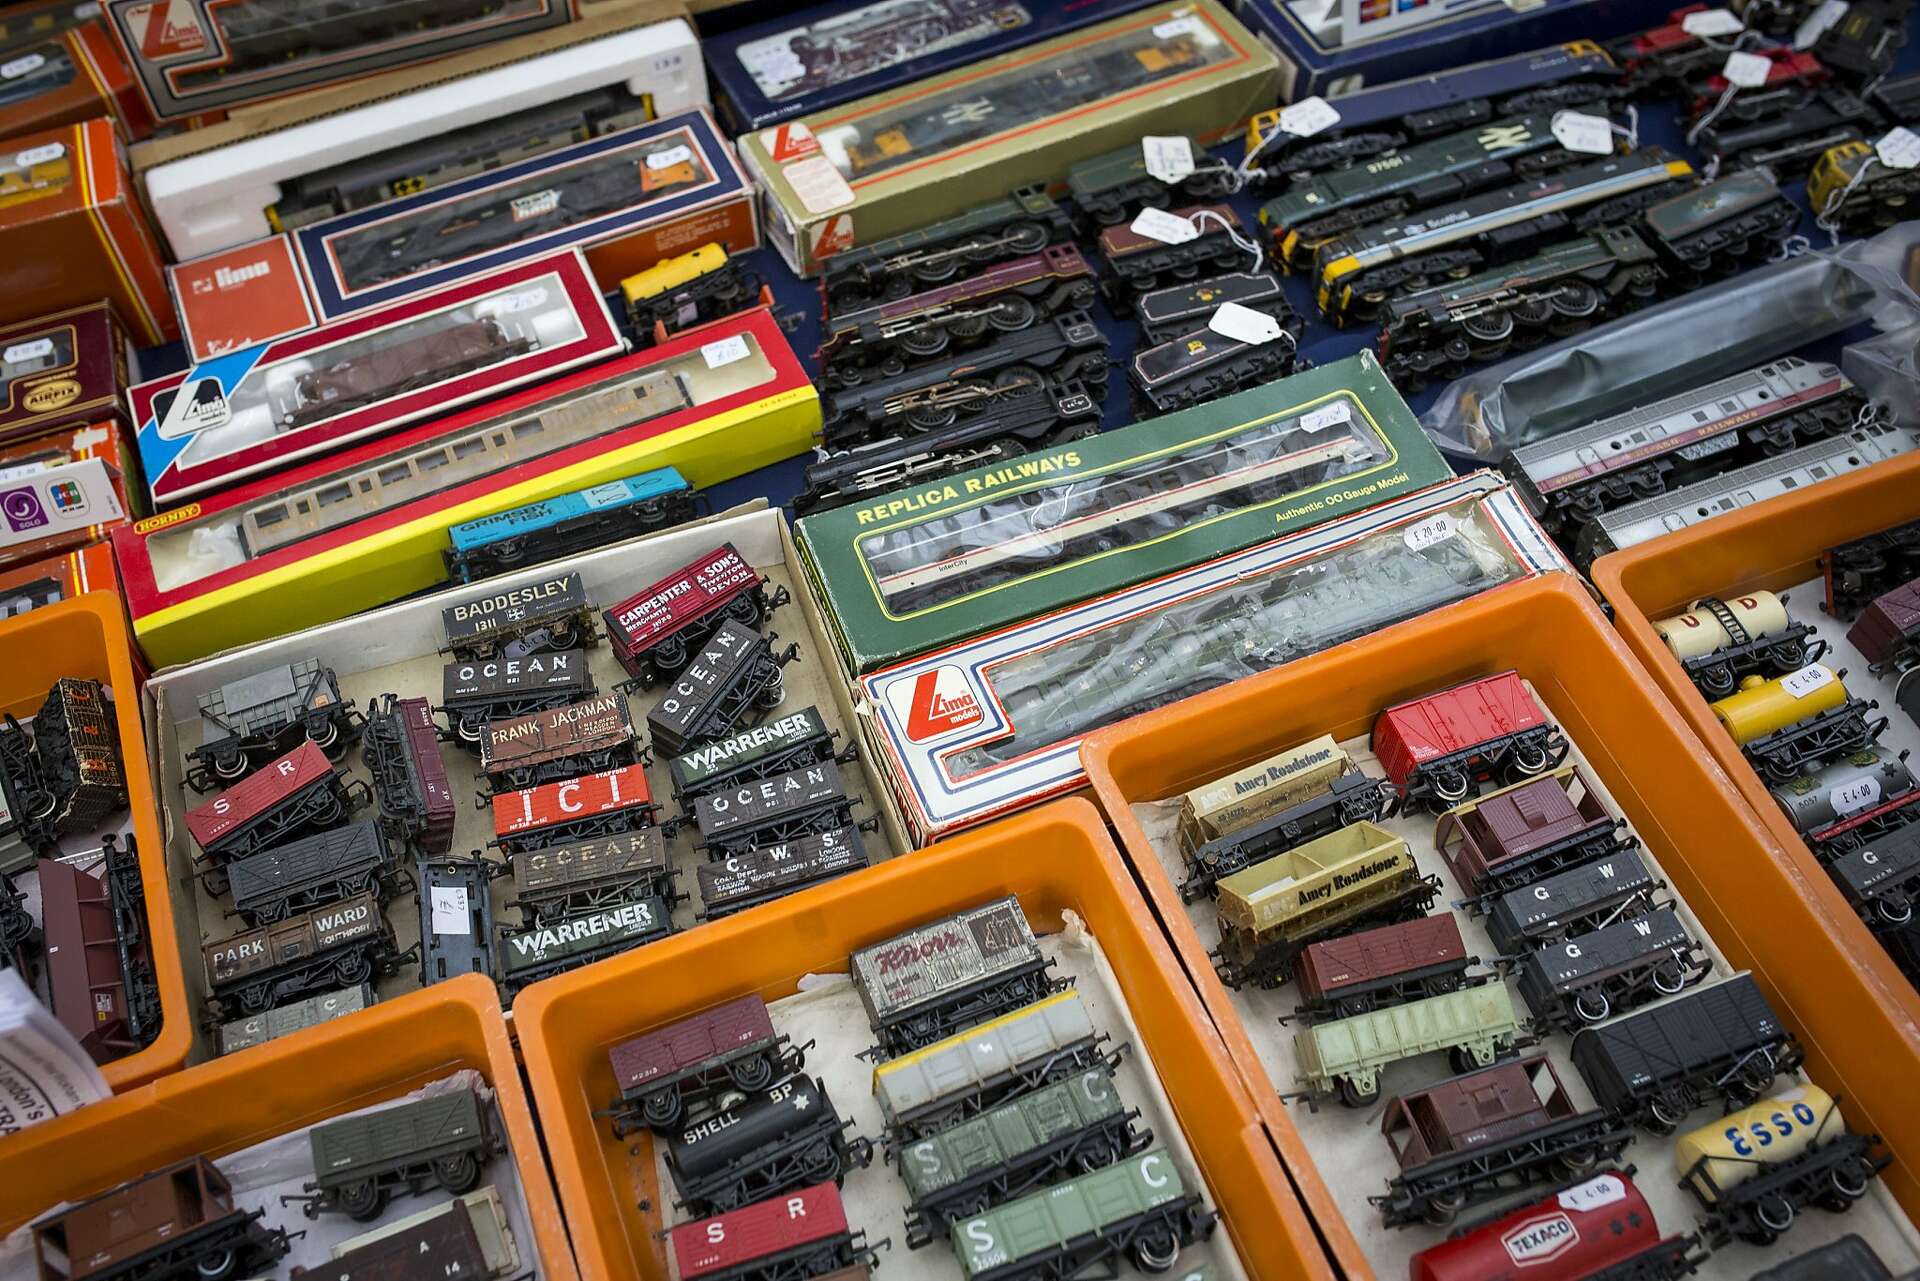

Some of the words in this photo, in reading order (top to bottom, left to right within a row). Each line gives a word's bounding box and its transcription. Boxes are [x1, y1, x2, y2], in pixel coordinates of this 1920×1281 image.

[30, 387, 75, 405] AIRFIX
[856, 487, 959, 526] REPLICA
[964, 451, 1082, 493] RAILWAYS
[1275, 501, 1325, 522] Authentic
[1343, 484, 1377, 501] Gauge
[1376, 472, 1410, 490] Model
[19, 518, 41, 530] SOLO
[137, 507, 196, 532] HORNBY
[460, 503, 546, 532] GRIMSBY
[507, 508, 553, 526] FISH
[708, 570, 748, 594] DEVON
[938, 558, 969, 573] InterCity
[454, 577, 570, 622] BADDESLEY
[619, 580, 692, 629] CARPENTER
[704, 553, 739, 577] SONS
[475, 618, 497, 632] 1311
[460, 655, 567, 680] OCEAN
[663, 631, 736, 713] OCEAN
[491, 719, 541, 746] FRANK
[549, 696, 617, 728] JACKMAN
[950, 706, 980, 725] models
[682, 713, 811, 771] WARRENER
[213, 798, 230, 815] S
[276, 759, 297, 777] R
[559, 777, 580, 787] WORKS
[595, 768, 628, 779] STAFFORD
[712, 767, 825, 812] OCEAN
[1234, 772, 1268, 795] Amey
[1266, 749, 1331, 780] Roadstone
[518, 787, 537, 796] SALT
[1862, 851, 1879, 864] G
[1298, 883, 1331, 906] Amey
[1333, 855, 1400, 890] Roadstone
[1534, 887, 1550, 900] G
[1598, 863, 1615, 879] W
[213, 939, 264, 966] PARK
[316, 905, 368, 932] WARD
[512, 903, 652, 955] WARRENER
[1565, 943, 1582, 958] G
[1634, 920, 1651, 936] W
[769, 1084, 793, 1104] BP
[683, 1111, 741, 1145] SHELL
[914, 1143, 941, 1174] S
[1081, 1071, 1108, 1102] C
[707, 1222, 725, 1244] S
[787, 1197, 806, 1220] R
[966, 1219, 994, 1253] S
[1140, 1156, 1168, 1188] C
[1512, 1220, 1569, 1253] TEXACO
